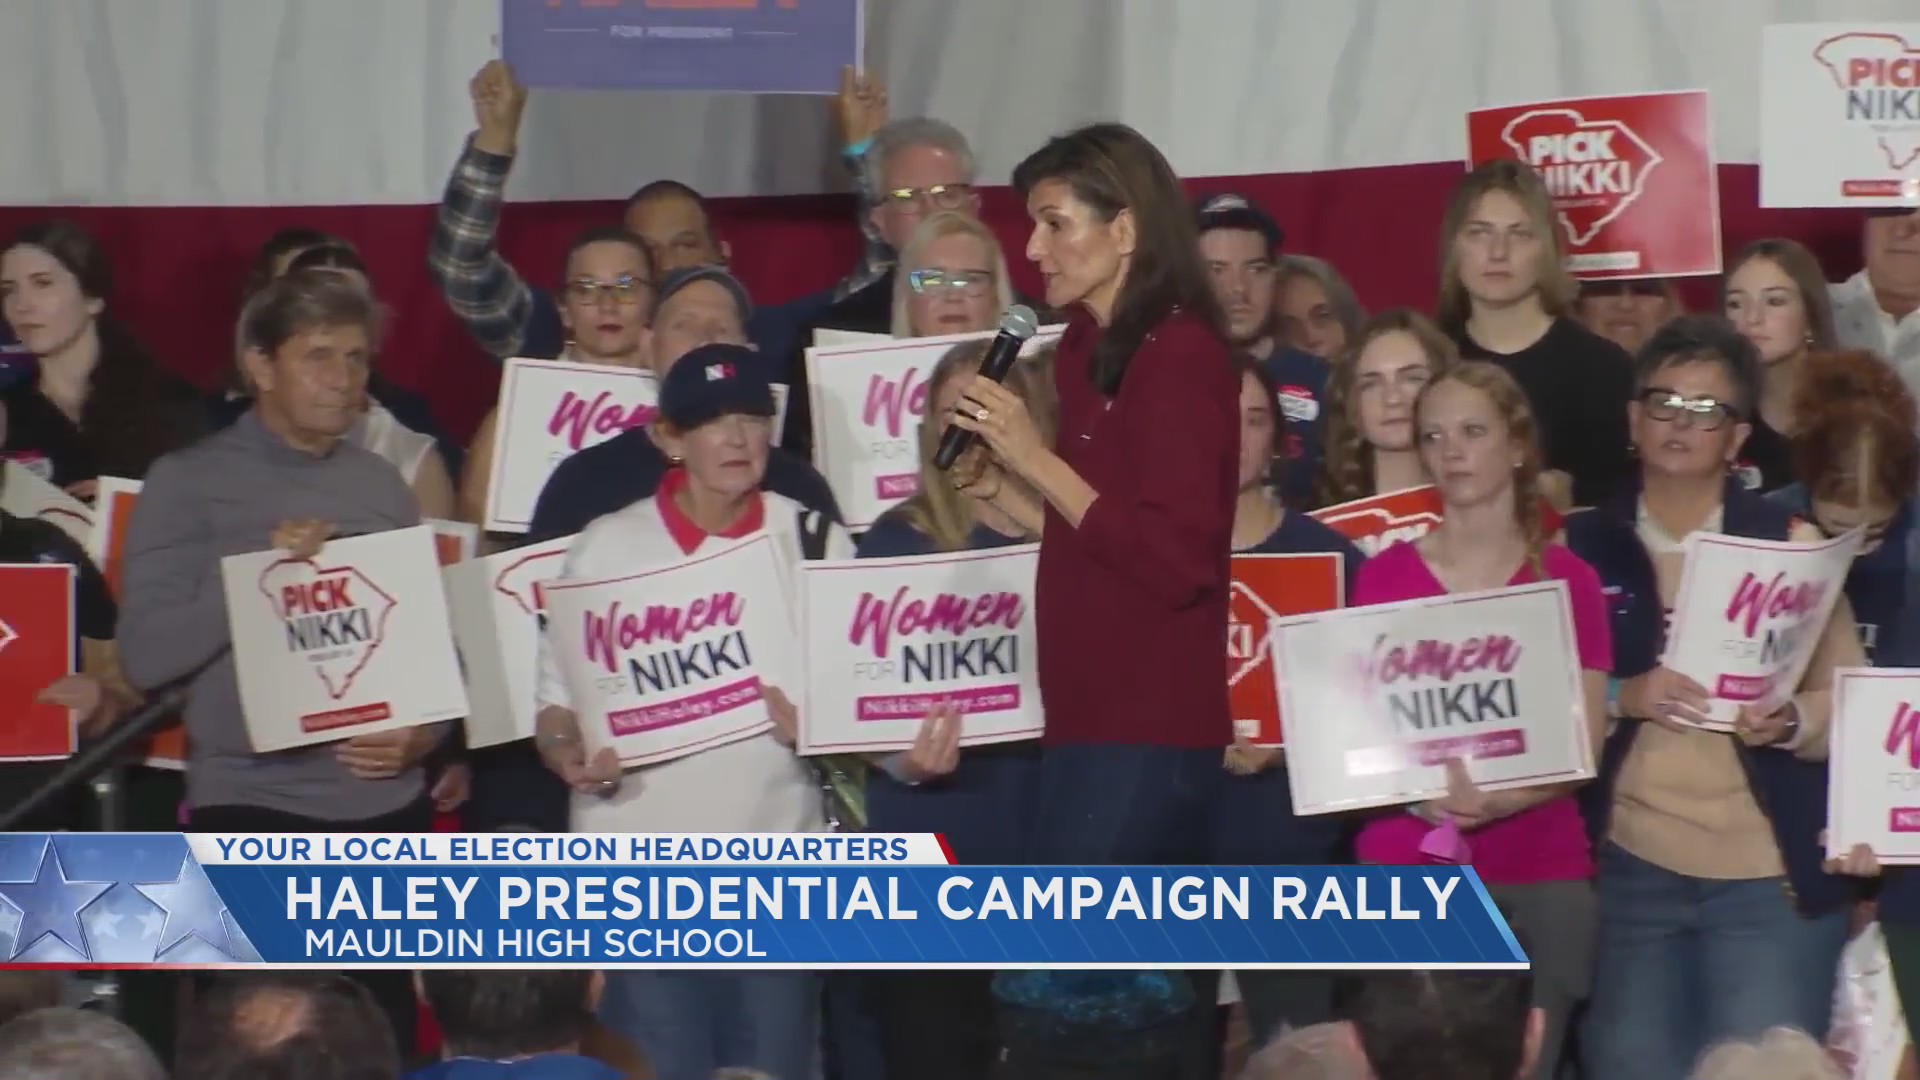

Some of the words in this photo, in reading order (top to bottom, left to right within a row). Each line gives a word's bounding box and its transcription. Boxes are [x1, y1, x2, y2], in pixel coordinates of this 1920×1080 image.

[1847, 89, 1920, 120] NIK
[1529, 129, 1619, 166] PICK
[282, 577, 354, 618] PICK
[850, 586, 1025, 658] Women
[287, 607, 372, 653] NIKKI
[585, 592, 746, 673] Women
[629, 630, 751, 695] NIKKI
[903, 635, 1018, 683] NIKKI
[1362, 632, 1521, 690] omen
[1389, 678, 1520, 731] NIKKI
